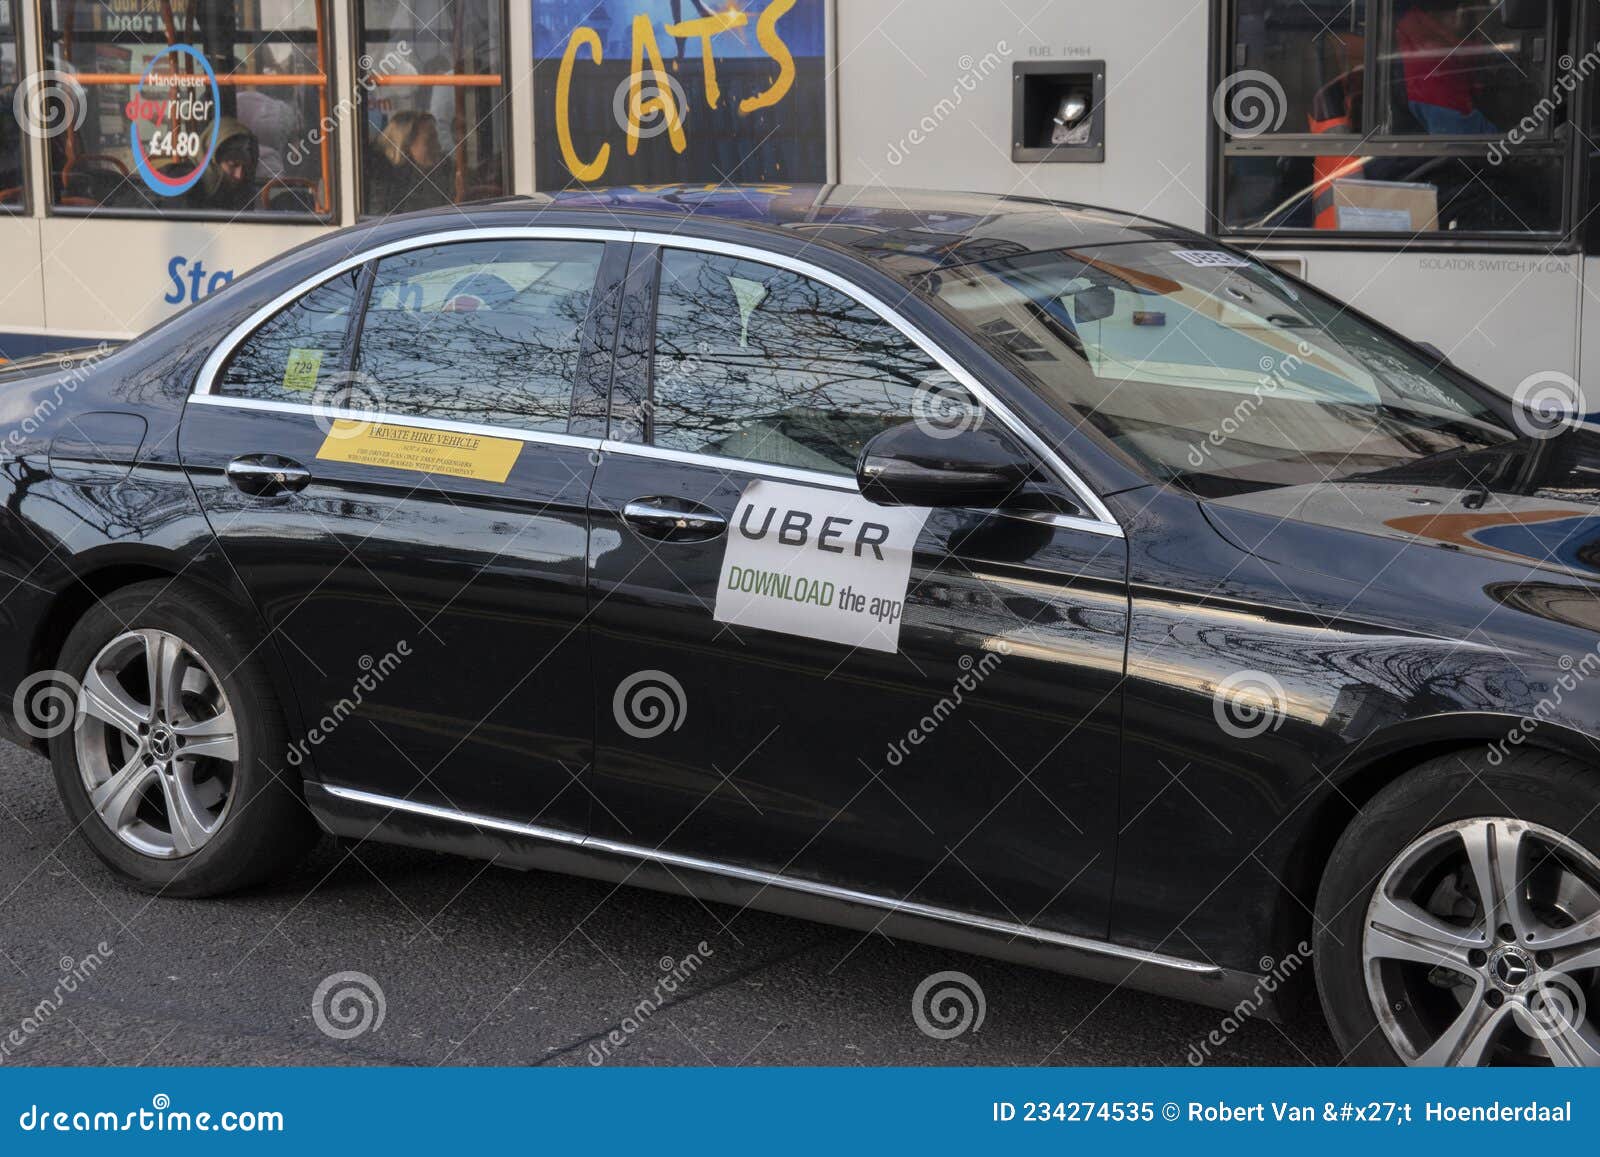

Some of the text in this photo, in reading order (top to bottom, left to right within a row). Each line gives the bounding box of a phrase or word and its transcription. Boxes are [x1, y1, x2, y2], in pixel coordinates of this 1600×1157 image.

[1028, 47, 1052, 56] FUEL
[148, 73, 206, 87] Manchester
[555, 0, 797, 182] CATS
[126, 92, 213, 128] dayrider
[149, 131, 200, 157] £4.80
[1419, 259, 1475, 270] ISOLATOR
[1479, 261, 1526, 272] SWITCH
[1529, 262, 1541, 272] IN
[368, 426, 481, 448] PRIVATE HIRE VEHICLE
[739, 503, 890, 561] UBER
[727, 566, 902, 624] DOWNLOAD the app
